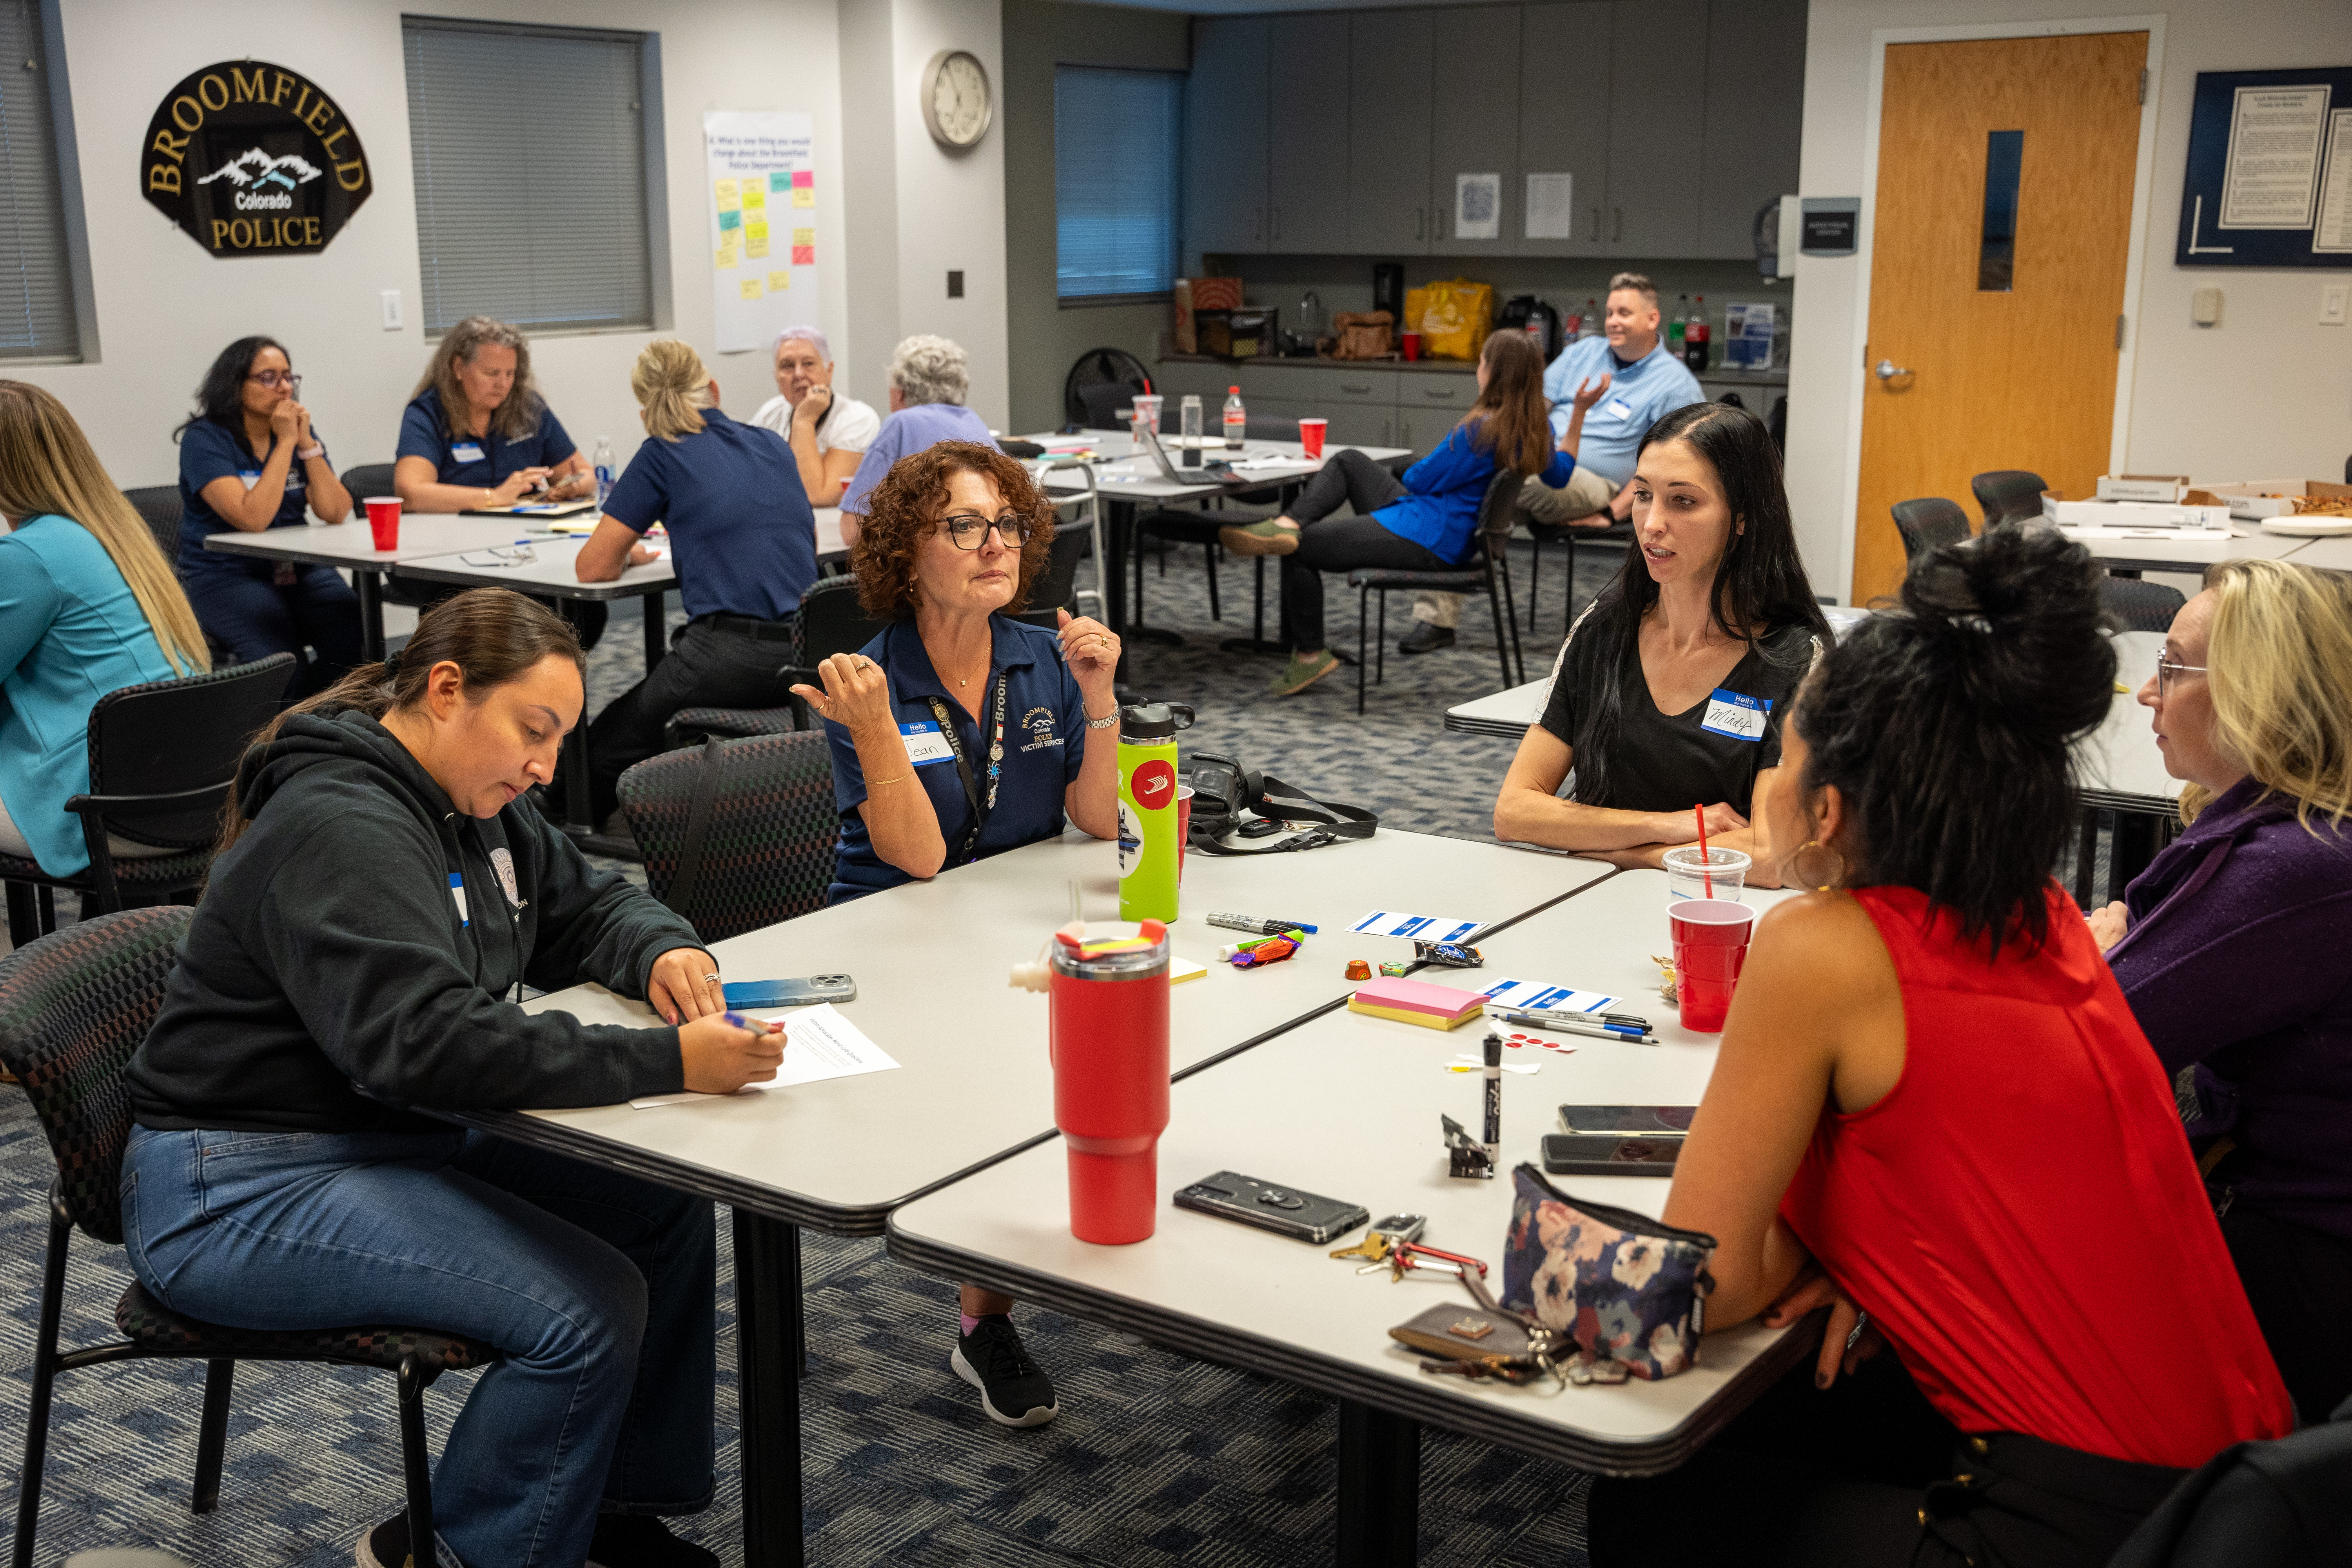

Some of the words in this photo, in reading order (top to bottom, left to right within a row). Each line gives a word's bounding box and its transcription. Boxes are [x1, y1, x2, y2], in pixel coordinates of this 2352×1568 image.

[149, 67, 365, 196] BROOMFIELD
[236, 191, 292, 210] Colorado
[211, 216, 323, 249] POLICE
[1735, 695, 1754, 705] Hello
[1022, 707, 1056, 729] BROOMFIELD
[1709, 707, 1752, 735] Mindy
[941, 720, 964, 763] Police
[1020, 742, 1044, 753] VICTIM
[1044, 738, 1065, 747] SERVICES
[1033, 733, 1053, 742] POLICE
[903, 739, 939, 757] Jean
[496, 857, 509, 868] POLICE
[1543, 997, 1558, 1005] Hello
